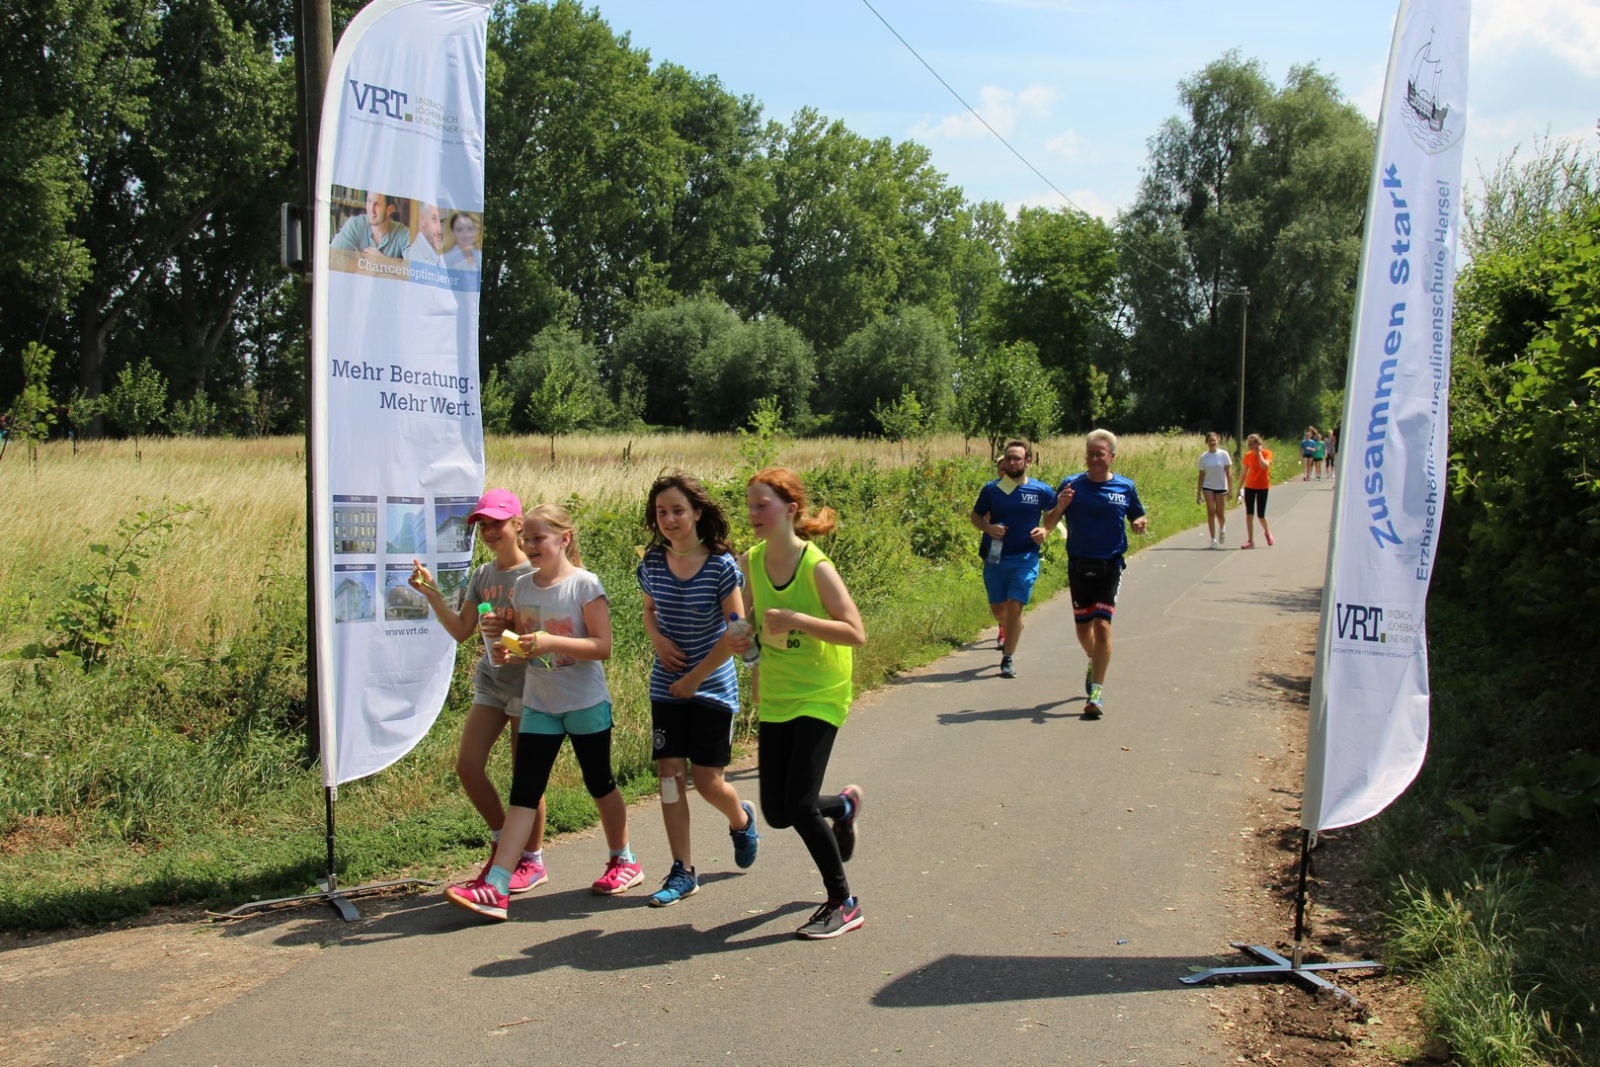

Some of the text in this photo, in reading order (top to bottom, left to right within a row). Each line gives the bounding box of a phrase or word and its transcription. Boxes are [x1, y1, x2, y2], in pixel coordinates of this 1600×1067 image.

[1435, 180, 1450, 243] Hersel
[357, 258, 459, 286] Chancenoptimierer
[332, 359, 474, 393] Mehr Beratung.
[380, 391, 475, 416] Mehr Wert.
[1363, 302, 1406, 549] Zusammen
[385, 626, 429, 636] www.vrt.de
